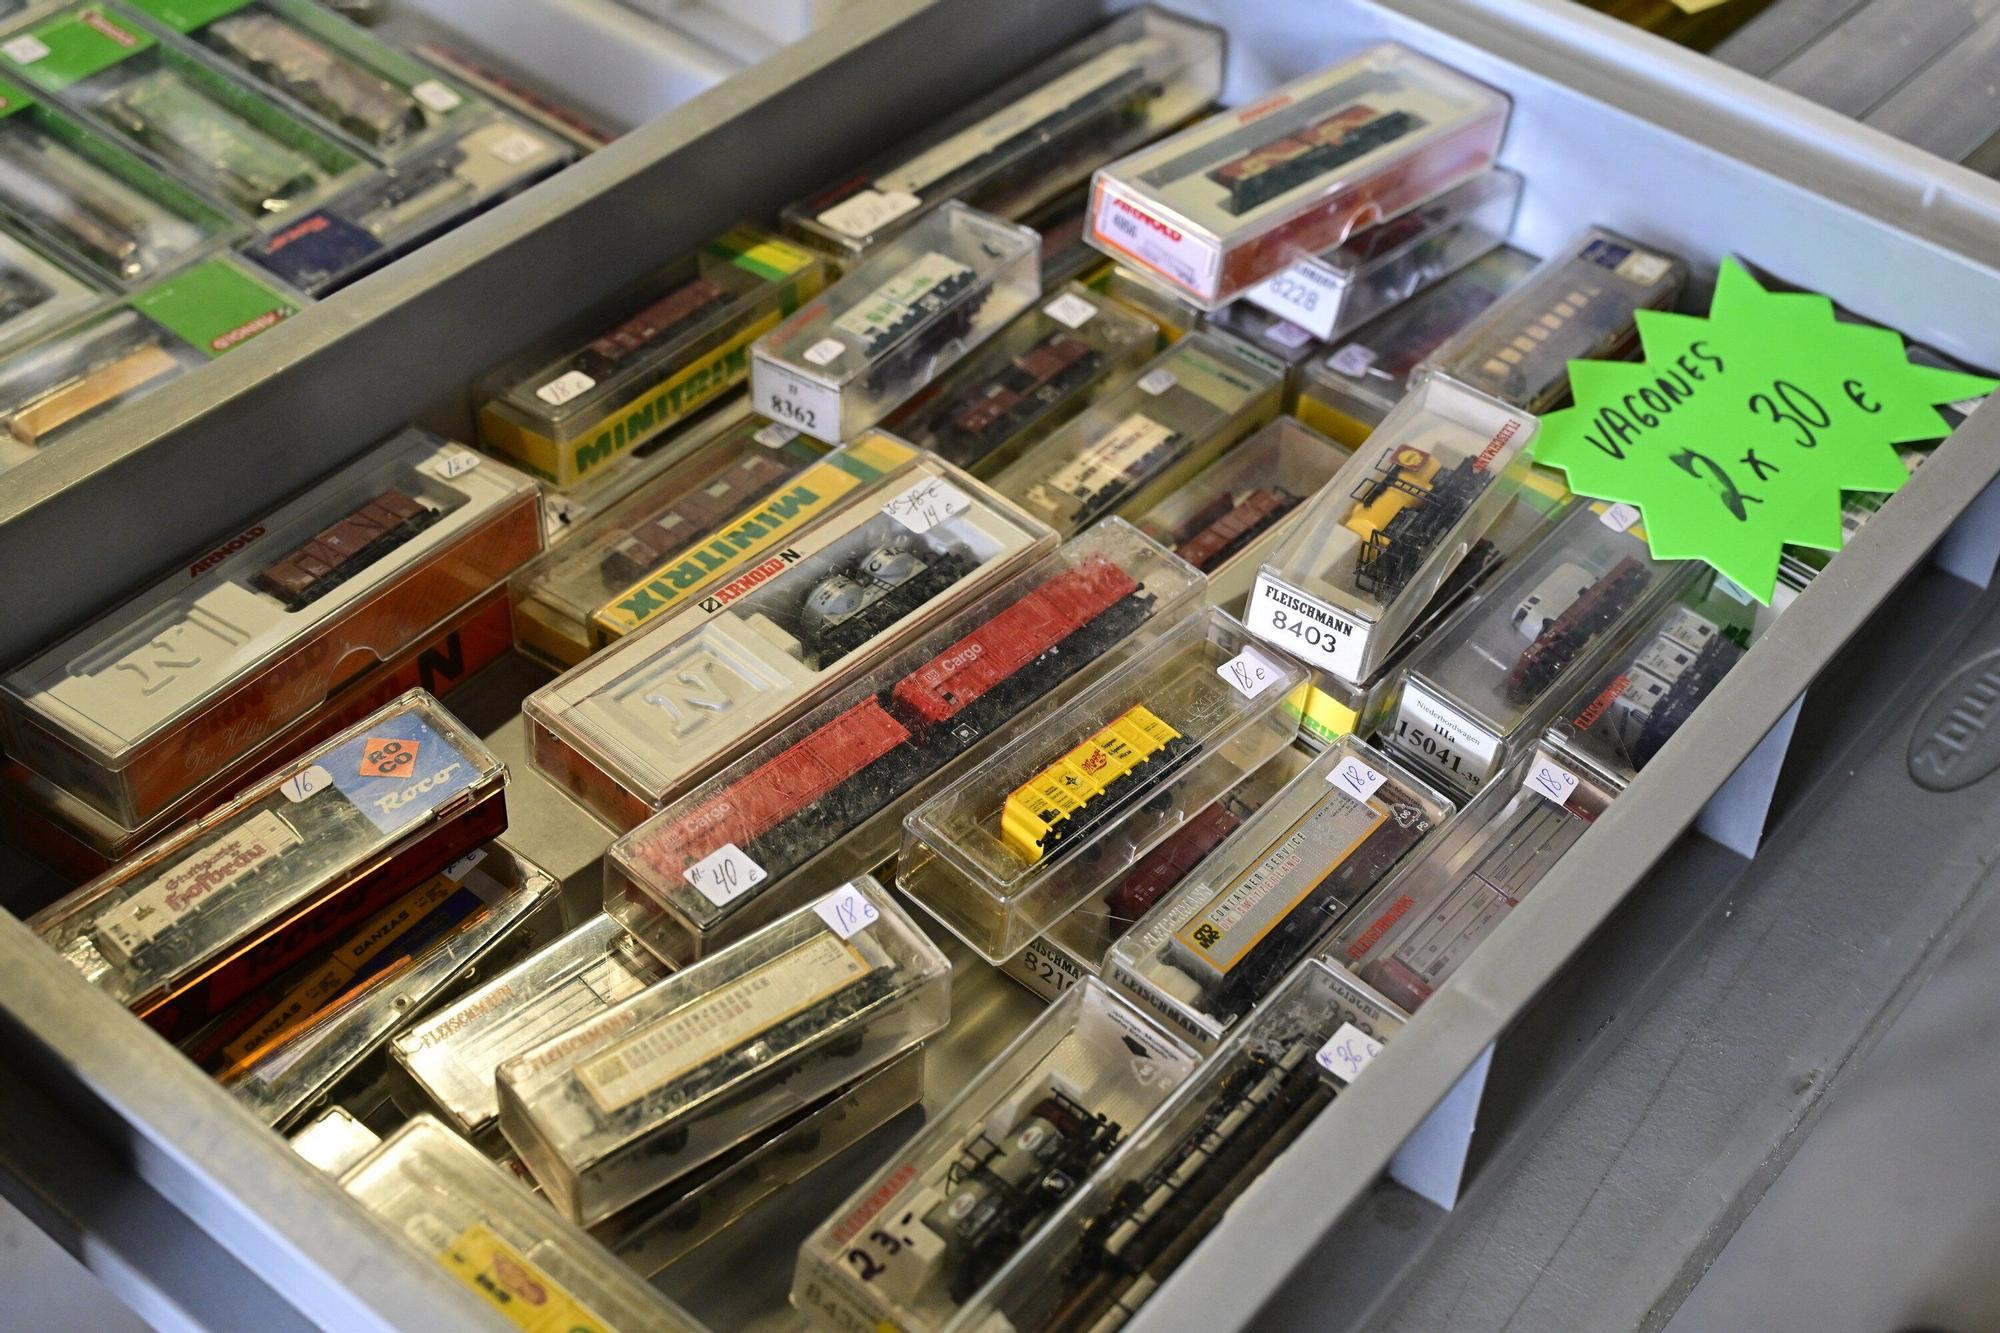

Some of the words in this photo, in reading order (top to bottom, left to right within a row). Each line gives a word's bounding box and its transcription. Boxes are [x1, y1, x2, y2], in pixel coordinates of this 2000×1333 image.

[770, 394, 817, 430] 8362
[1584, 340, 1724, 460] VAGONES
[1668, 447, 1764, 522] 2
[1748, 379, 1831, 449] 30
[1843, 379, 1882, 413] €
[188, 525, 267, 579] ARNOLD
[617, 485, 822, 622] MINITRIX
[1264, 585, 1354, 638] FLEISCHMANN
[1271, 610, 1338, 654] 8403
[923, 667, 941, 684] DB
[941, 641, 983, 674] Cargo
[1229, 660, 1255, 692] 18
[1256, 667, 1267, 681] €
[1416, 699, 1482, 747] Niederbordwagen
[366, 741, 403, 767] RO
[377, 751, 413, 775] CO
[292, 770, 315, 799] 16
[373, 761, 462, 816] Roco
[1340, 764, 1365, 794] 18
[1535, 767, 1563, 798] 18
[685, 801, 732, 834] Cargo
[712, 858, 738, 897] 40
[1209, 871, 1265, 923] CONTAINER
[1264, 830, 1307, 872] SERVICE
[353, 909, 410, 957] DANZAS
[835, 895, 857, 933] 18
[1029, 939, 1084, 980] EISCHMA
[244, 1000, 302, 1052] DANZAS
